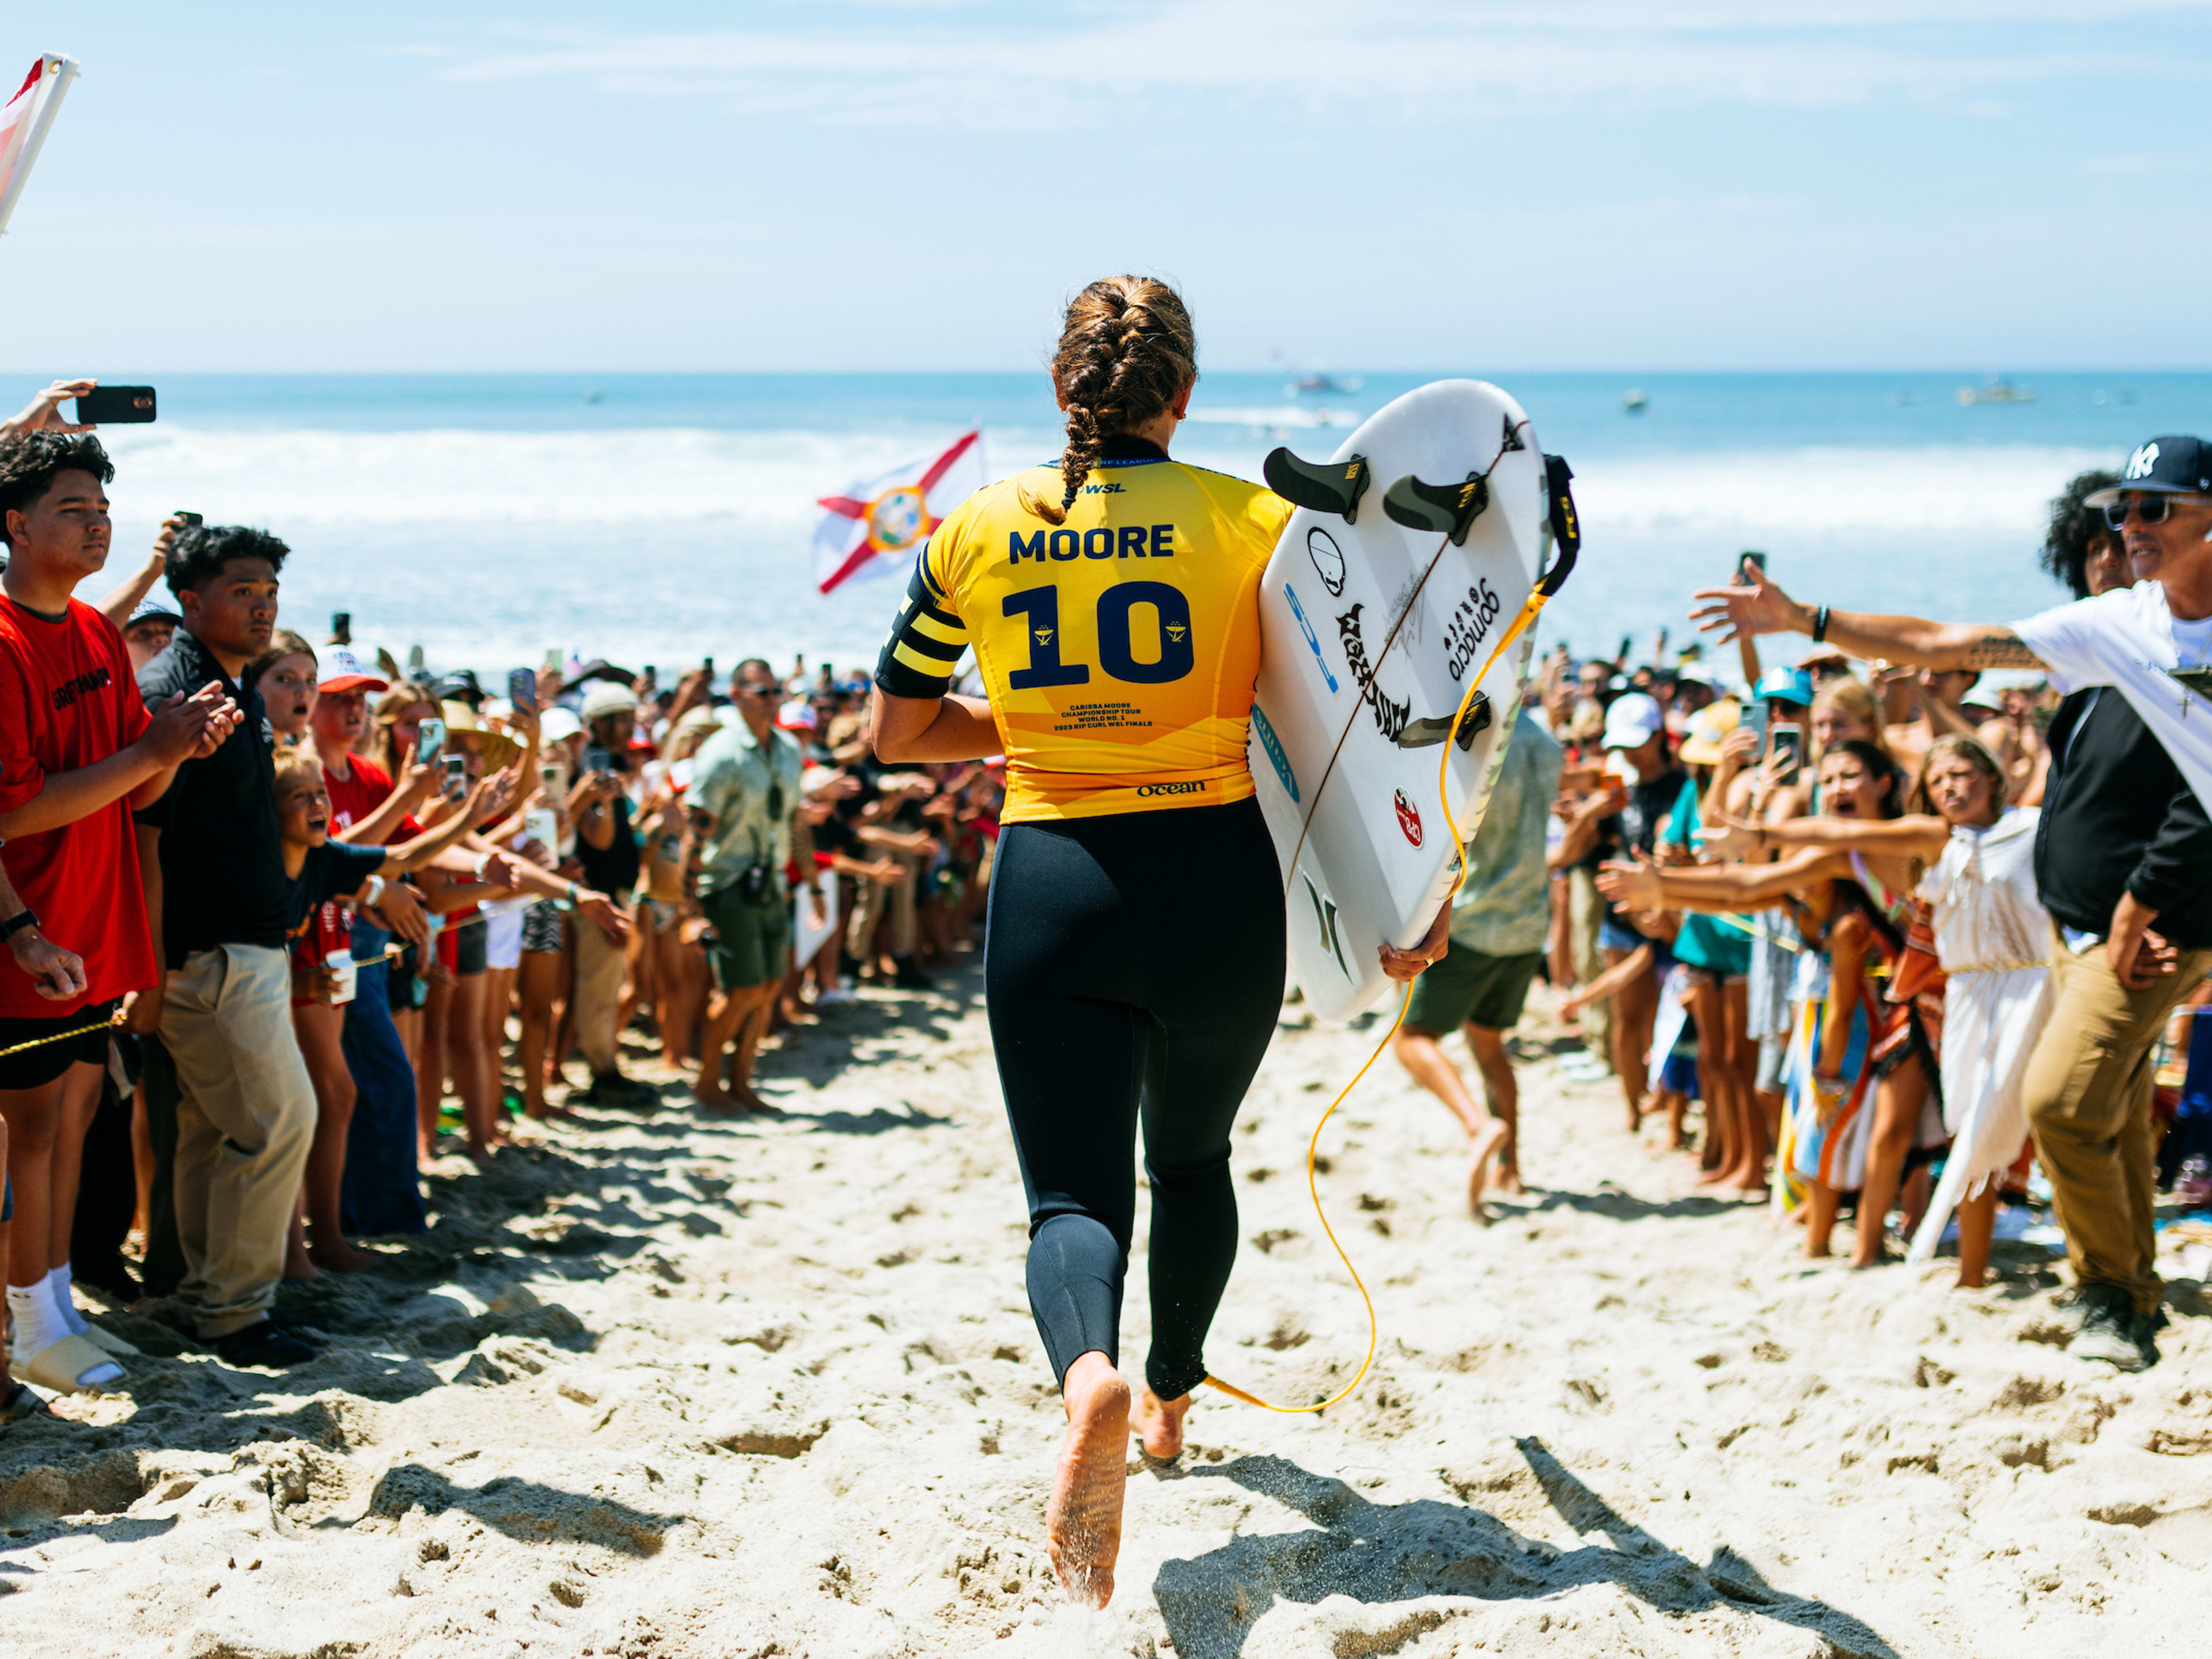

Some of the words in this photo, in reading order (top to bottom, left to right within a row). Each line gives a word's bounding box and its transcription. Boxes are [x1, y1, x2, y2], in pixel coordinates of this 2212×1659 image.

[1086, 483, 1127, 494] WSL
[1009, 524, 1175, 565] MOORE
[1002, 581, 1194, 690] 10
[1283, 583, 1339, 694] FCS
[1449, 578, 1500, 681] gomacro
[1062, 709, 1119, 718] CHAMPIONSHIP
[1137, 781, 1206, 797] Ocean
